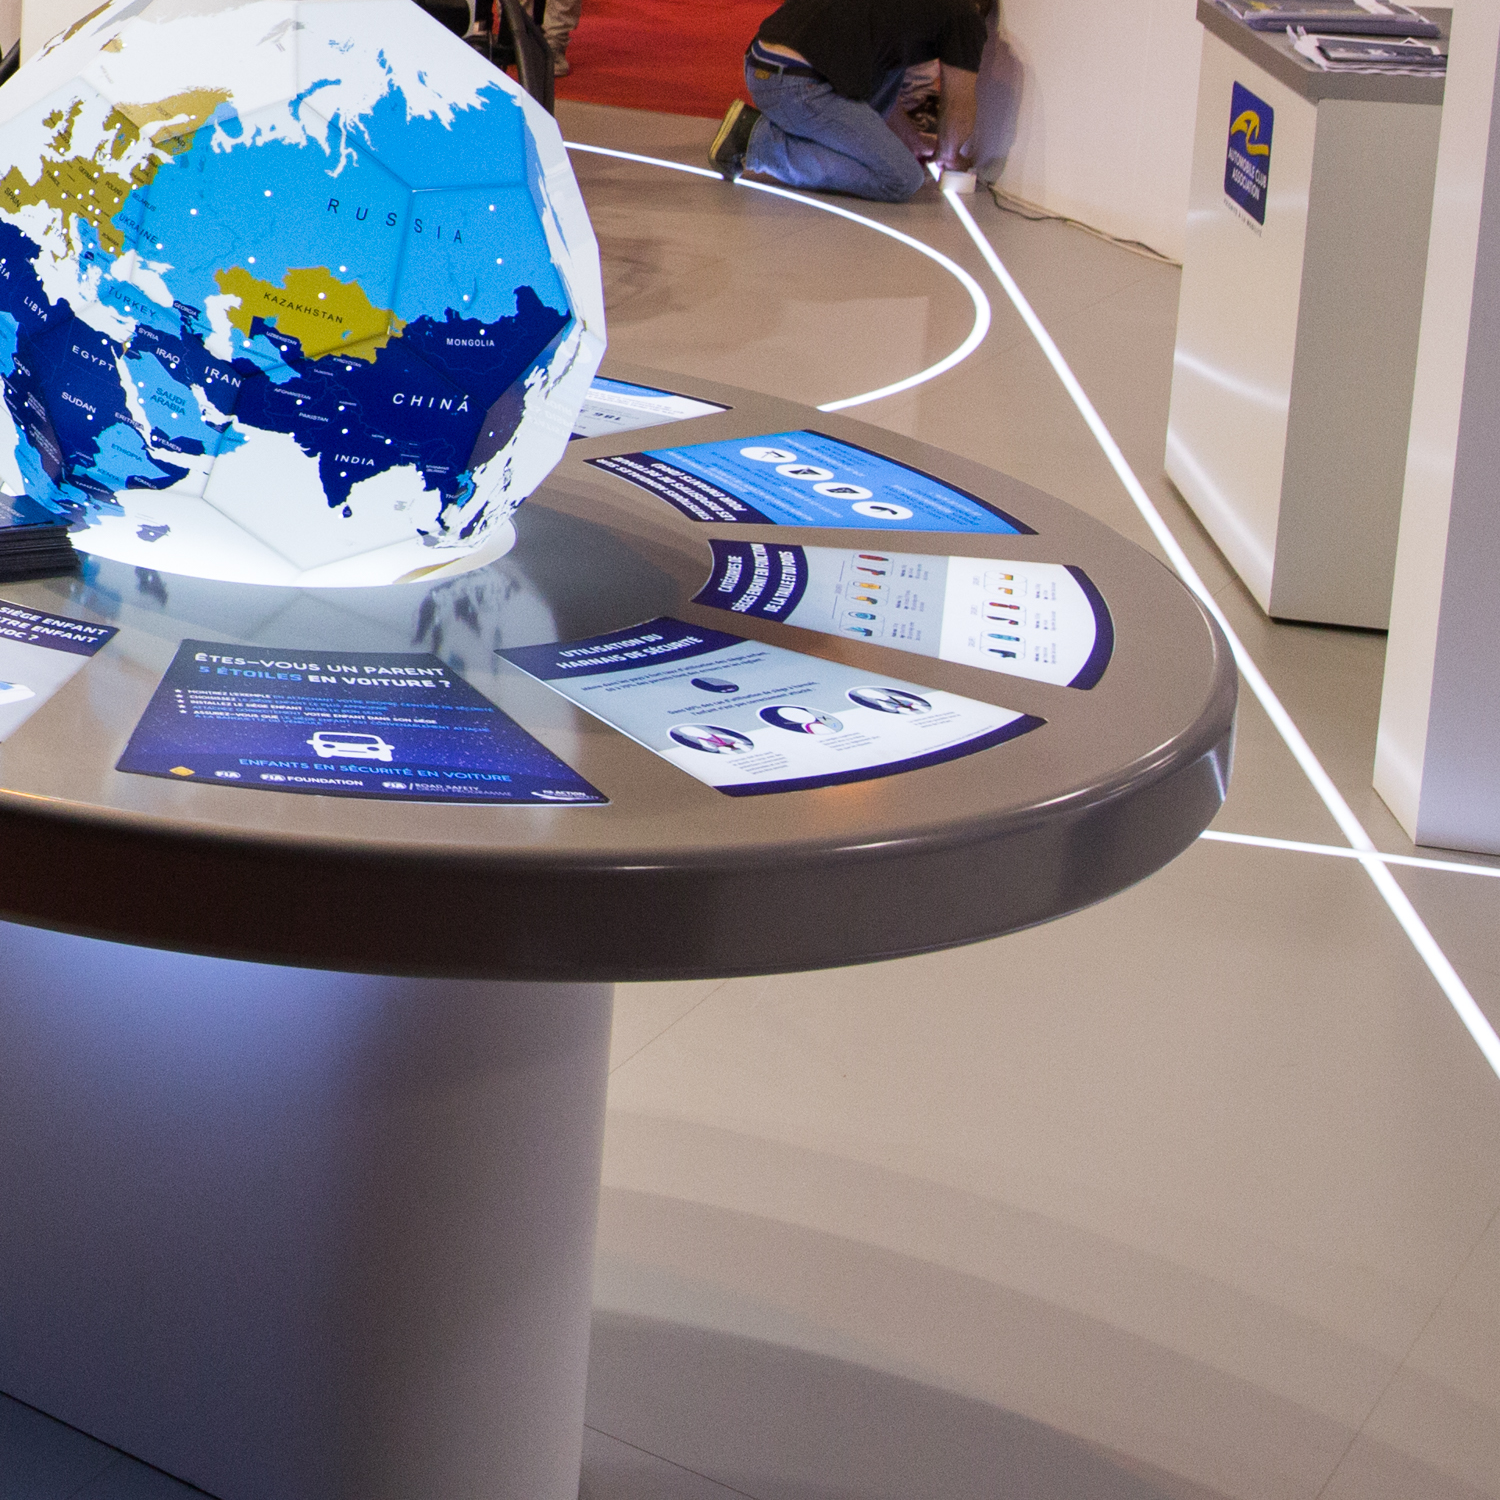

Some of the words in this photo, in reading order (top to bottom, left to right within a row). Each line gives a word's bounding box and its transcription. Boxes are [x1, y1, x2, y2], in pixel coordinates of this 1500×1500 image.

[1227, 147, 1255, 180] AUTOMOBILE
[1254, 169, 1268, 190] CLUB
[1231, 167, 1261, 201] ASSOCIATION
[3, 186, 22, 209] SPAIN
[118, 213, 159, 245] UKRAINE
[327, 197, 463, 245] RUSSIA
[22, 295, 49, 322] LIBYA
[108, 286, 158, 319] TURKEY
[263, 291, 344, 325] KAZAKHSTAN
[137, 326, 160, 343] SYRIA
[446, 337, 496, 348] MONGOLIA
[71, 344, 116, 373] EGYPT
[155, 347, 181, 366] IRAQ
[203, 365, 243, 389] IRAN
[60, 391, 98, 415] SUDAN
[149, 393, 186, 416] ARABIA
[154, 386, 186, 406] SAUDI
[157, 435, 182, 453] YEMEN
[334, 453, 376, 467] INDIA
[30, 624, 99, 644] ENFANT
[41, 617, 109, 636] ENFANT
[555, 652, 628, 670] HARNAIS
[628, 649, 643, 660] DE
[641, 635, 704, 660] SÉCURITÉ
[558, 634, 641, 659] UTILISATION
[644, 633, 665, 644] DU
[199, 665, 210, 675] 5
[216, 665, 304, 683] ÉTOILES
[307, 674, 337, 685] EN
[342, 675, 437, 689] VOITURE
[440, 679, 452, 689] ?
[327, 664, 359, 675] UN
[364, 664, 445, 678] PARENT
[238, 758, 311, 771] ENFANTS
[313, 763, 335, 772] EN
[339, 762, 413, 777] SÉCURITÉ
[418, 768, 441, 779] EN
[445, 770, 513, 783] VOITURE
[286, 775, 364, 787] FOUNDATION
